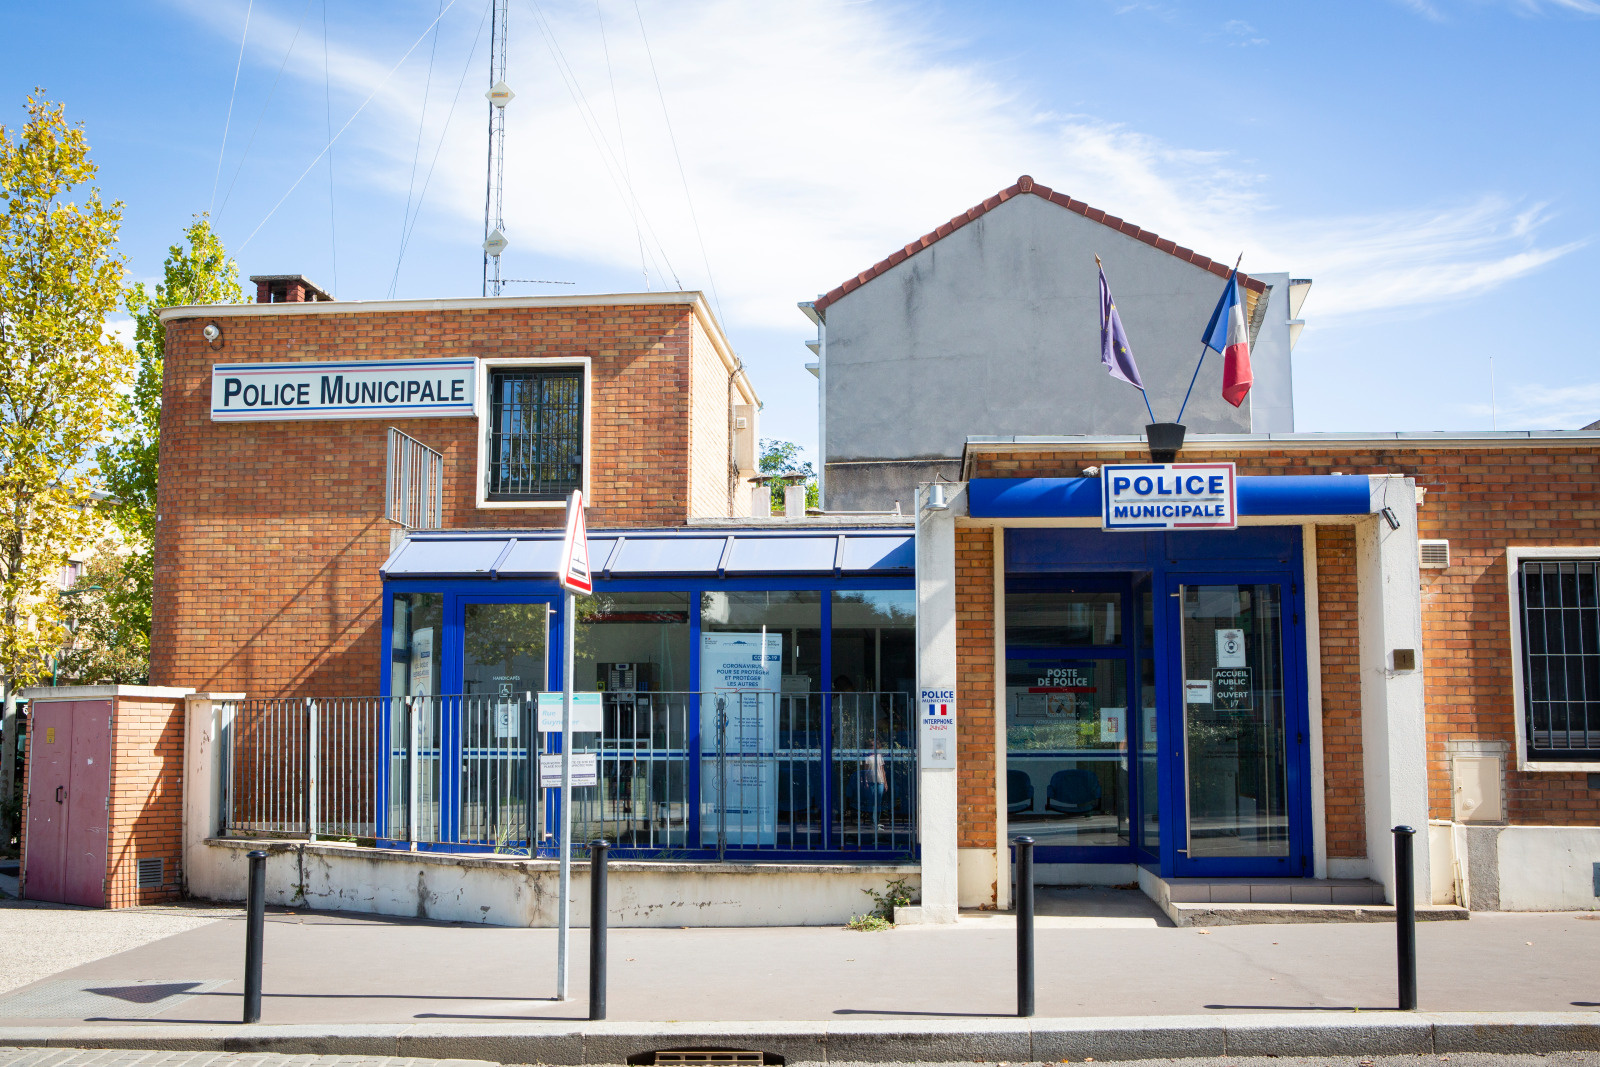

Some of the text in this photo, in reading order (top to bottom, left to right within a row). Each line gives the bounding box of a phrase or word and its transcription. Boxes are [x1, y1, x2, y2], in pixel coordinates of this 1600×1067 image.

[223, 375, 465, 407] POLICE MUNICIPALE
[1113, 475, 1225, 496] POLICE
[1114, 504, 1225, 518] MUNICIPALE
[1047, 668, 1078, 678] POSTE
[1037, 677, 1088, 687] DE POLICE
